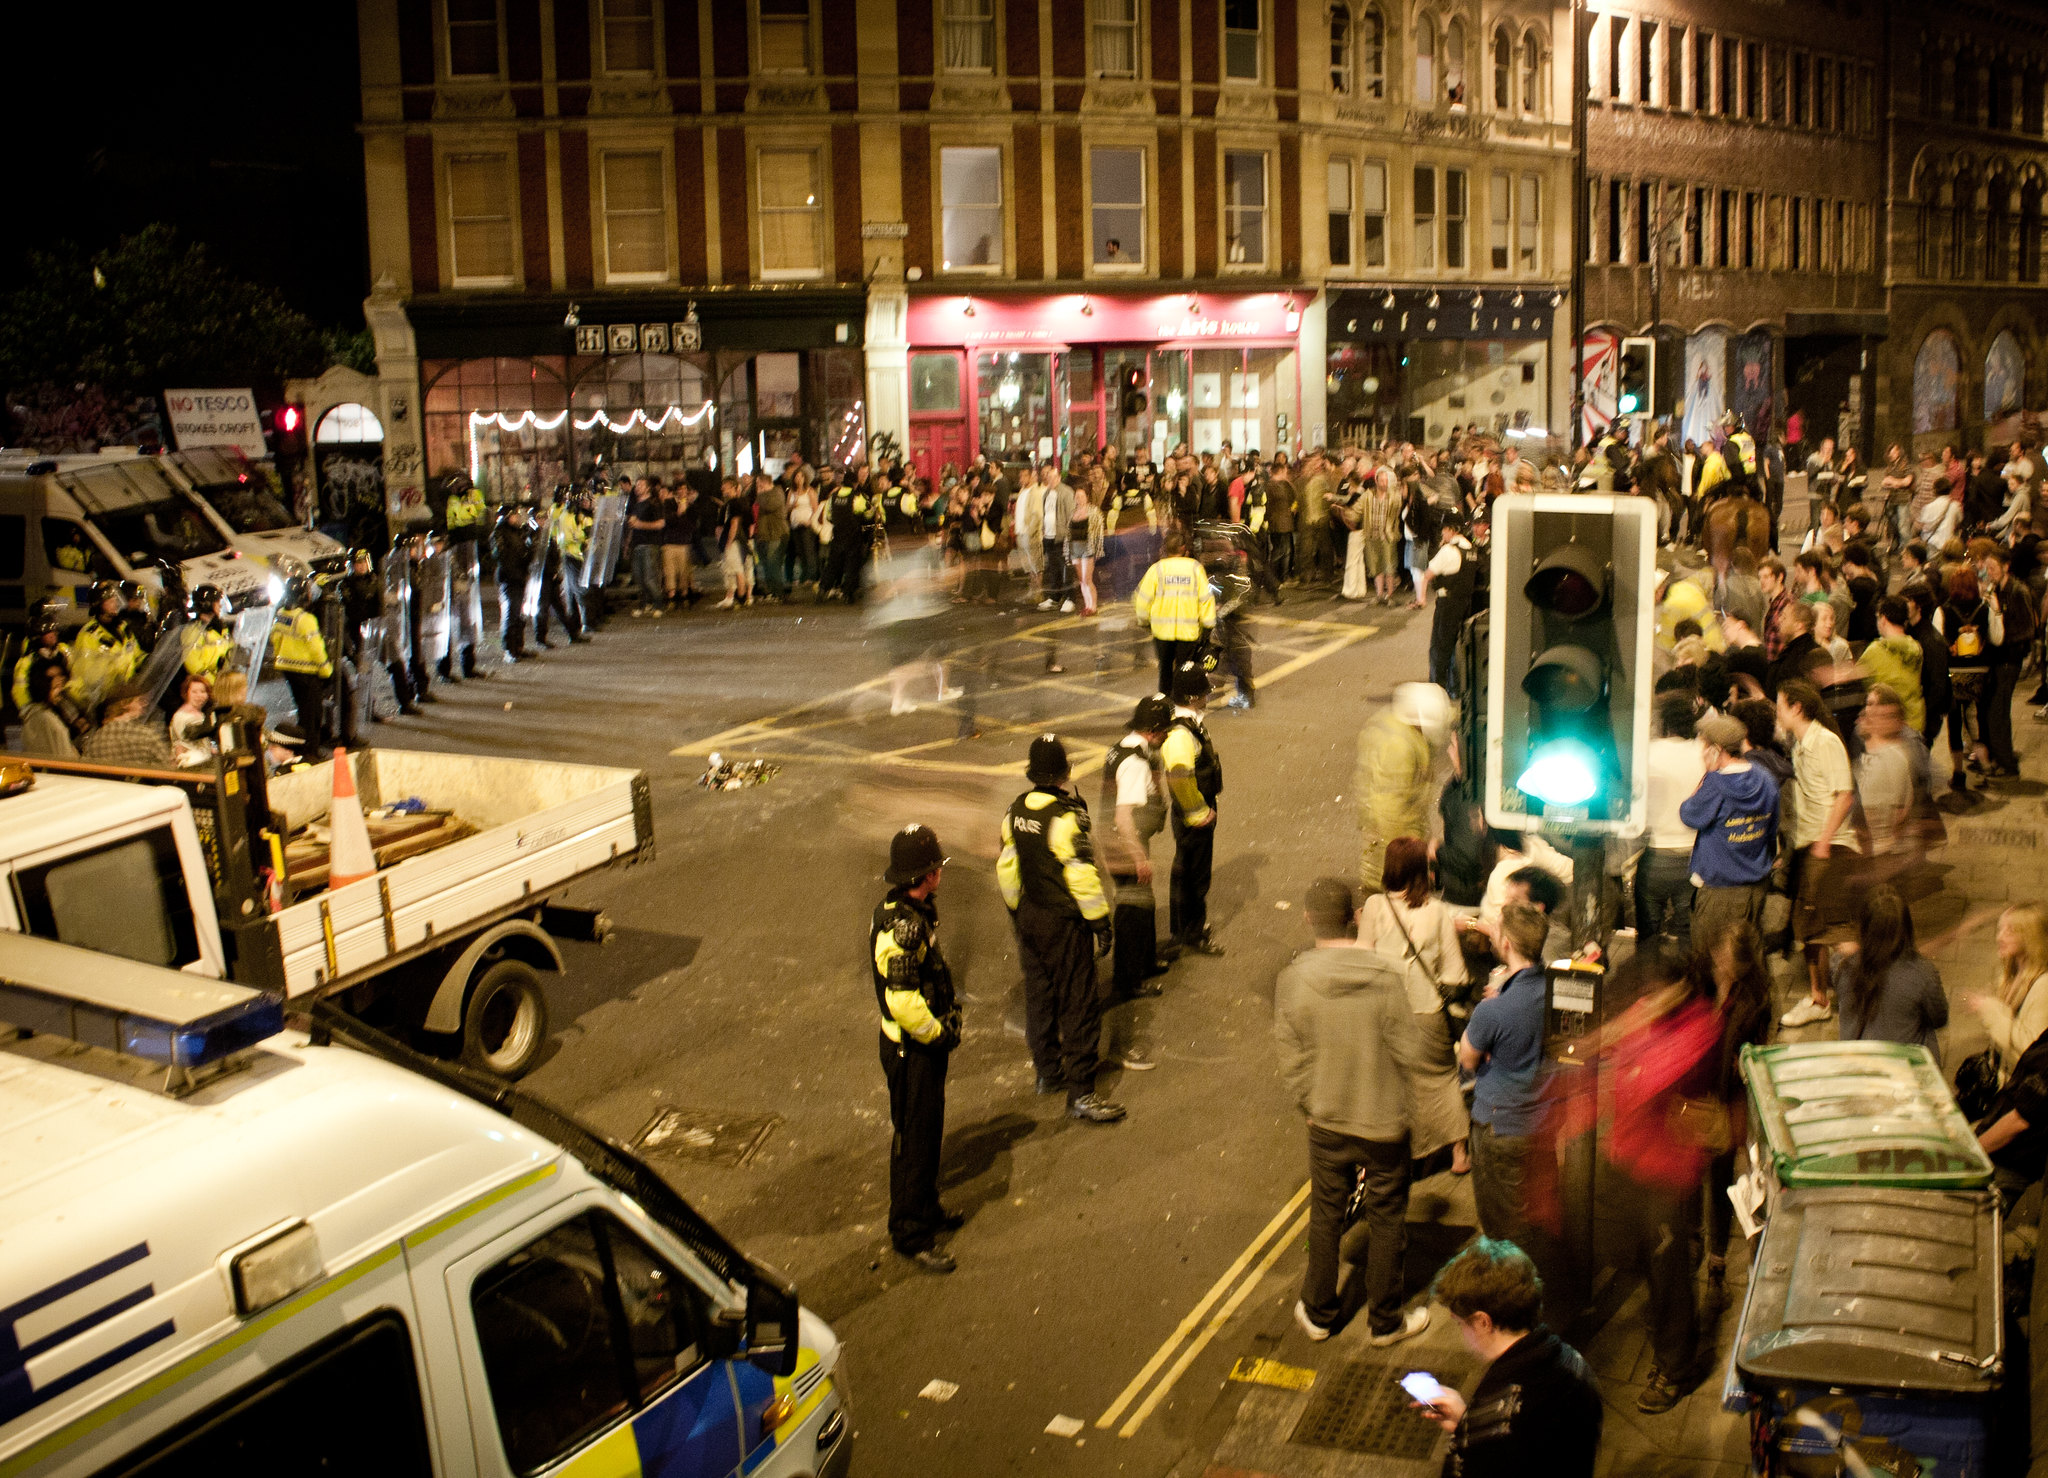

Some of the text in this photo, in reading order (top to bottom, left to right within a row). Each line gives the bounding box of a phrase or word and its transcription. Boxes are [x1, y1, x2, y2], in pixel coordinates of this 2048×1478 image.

[1679, 275, 1723, 299] MELT
[170, 396, 249, 411] NO TESCO
[175, 422, 256, 433] STOKES CROFT
